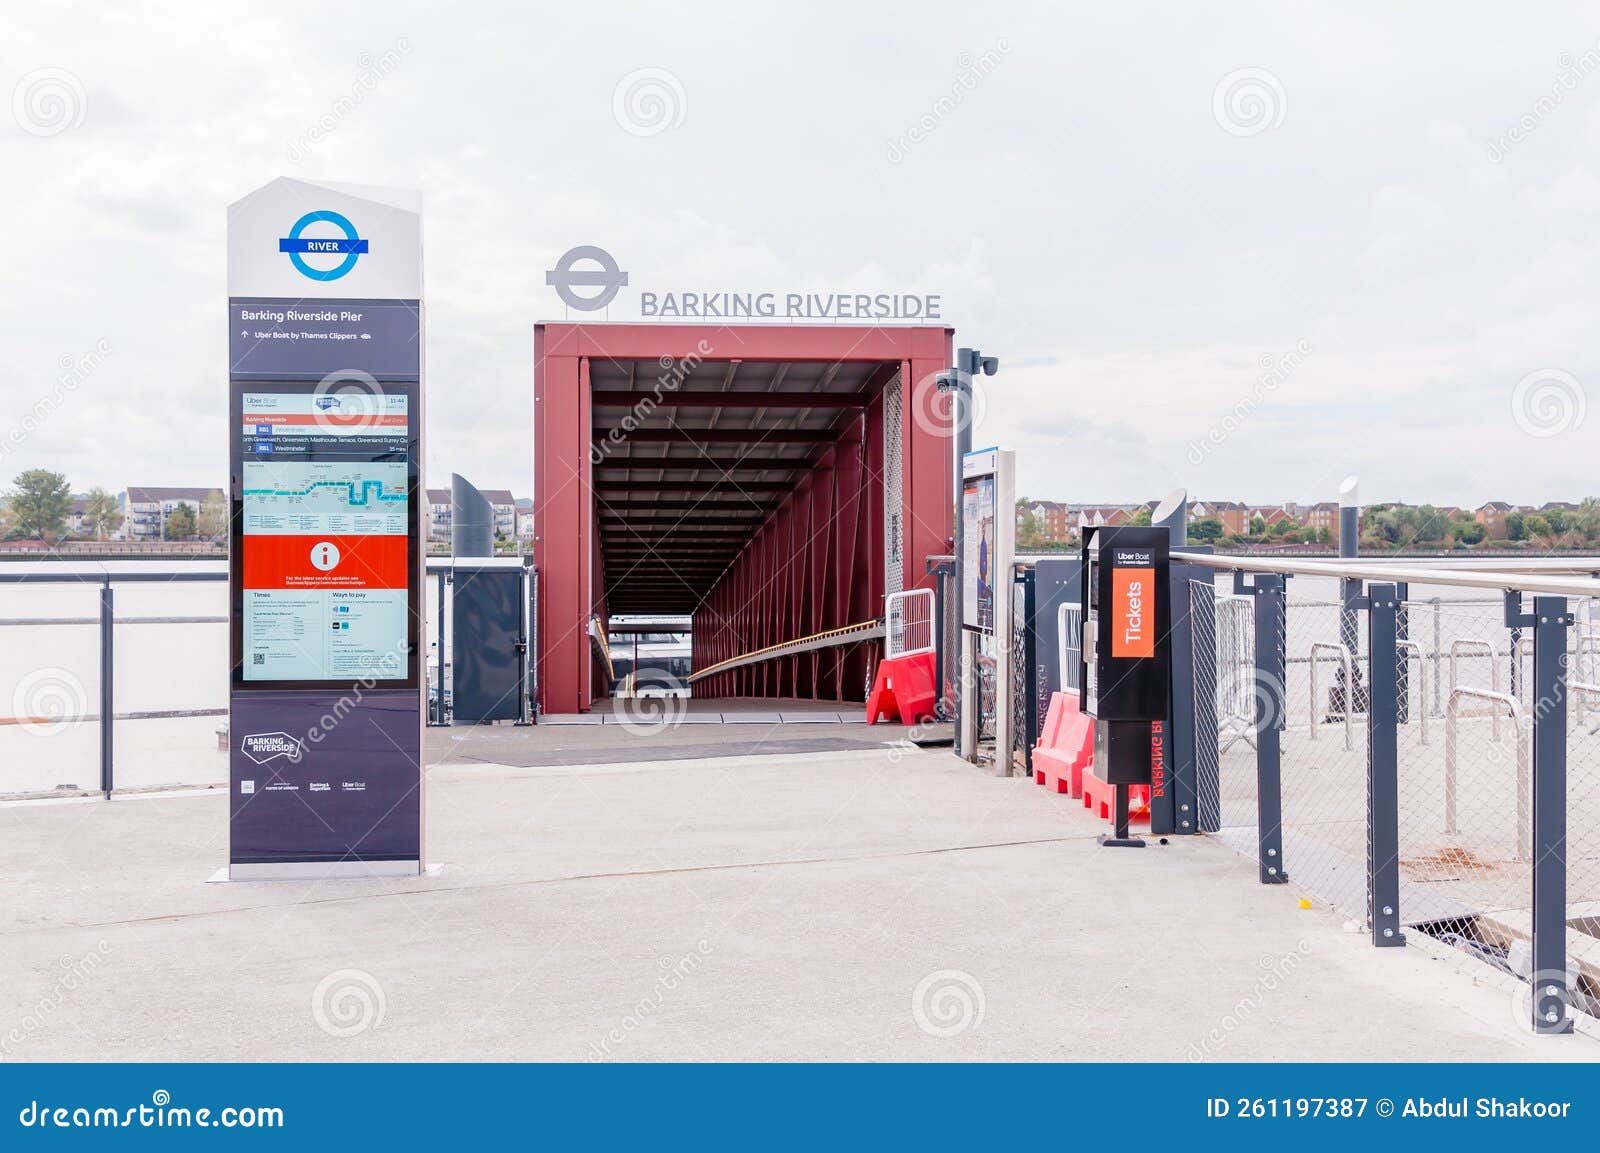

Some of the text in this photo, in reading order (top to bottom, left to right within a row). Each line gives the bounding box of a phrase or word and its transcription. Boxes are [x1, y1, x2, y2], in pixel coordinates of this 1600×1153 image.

[307, 241, 339, 251] RIVER
[641, 292, 941, 318] BARKING RIVERSIDE
[241, 310, 363, 322] Barking Riverside Pier
[254, 331, 272, 339] Uber
[291, 332, 300, 340] by
[301, 332, 328, 340] Thames
[329, 332, 358, 341] Clippers
[1117, 552, 1150, 560] Uber Boat
[1125, 580, 1142, 645] Tickets
[247, 737, 284, 745] BARKING
[253, 744, 295, 752] RIVERSIDE
